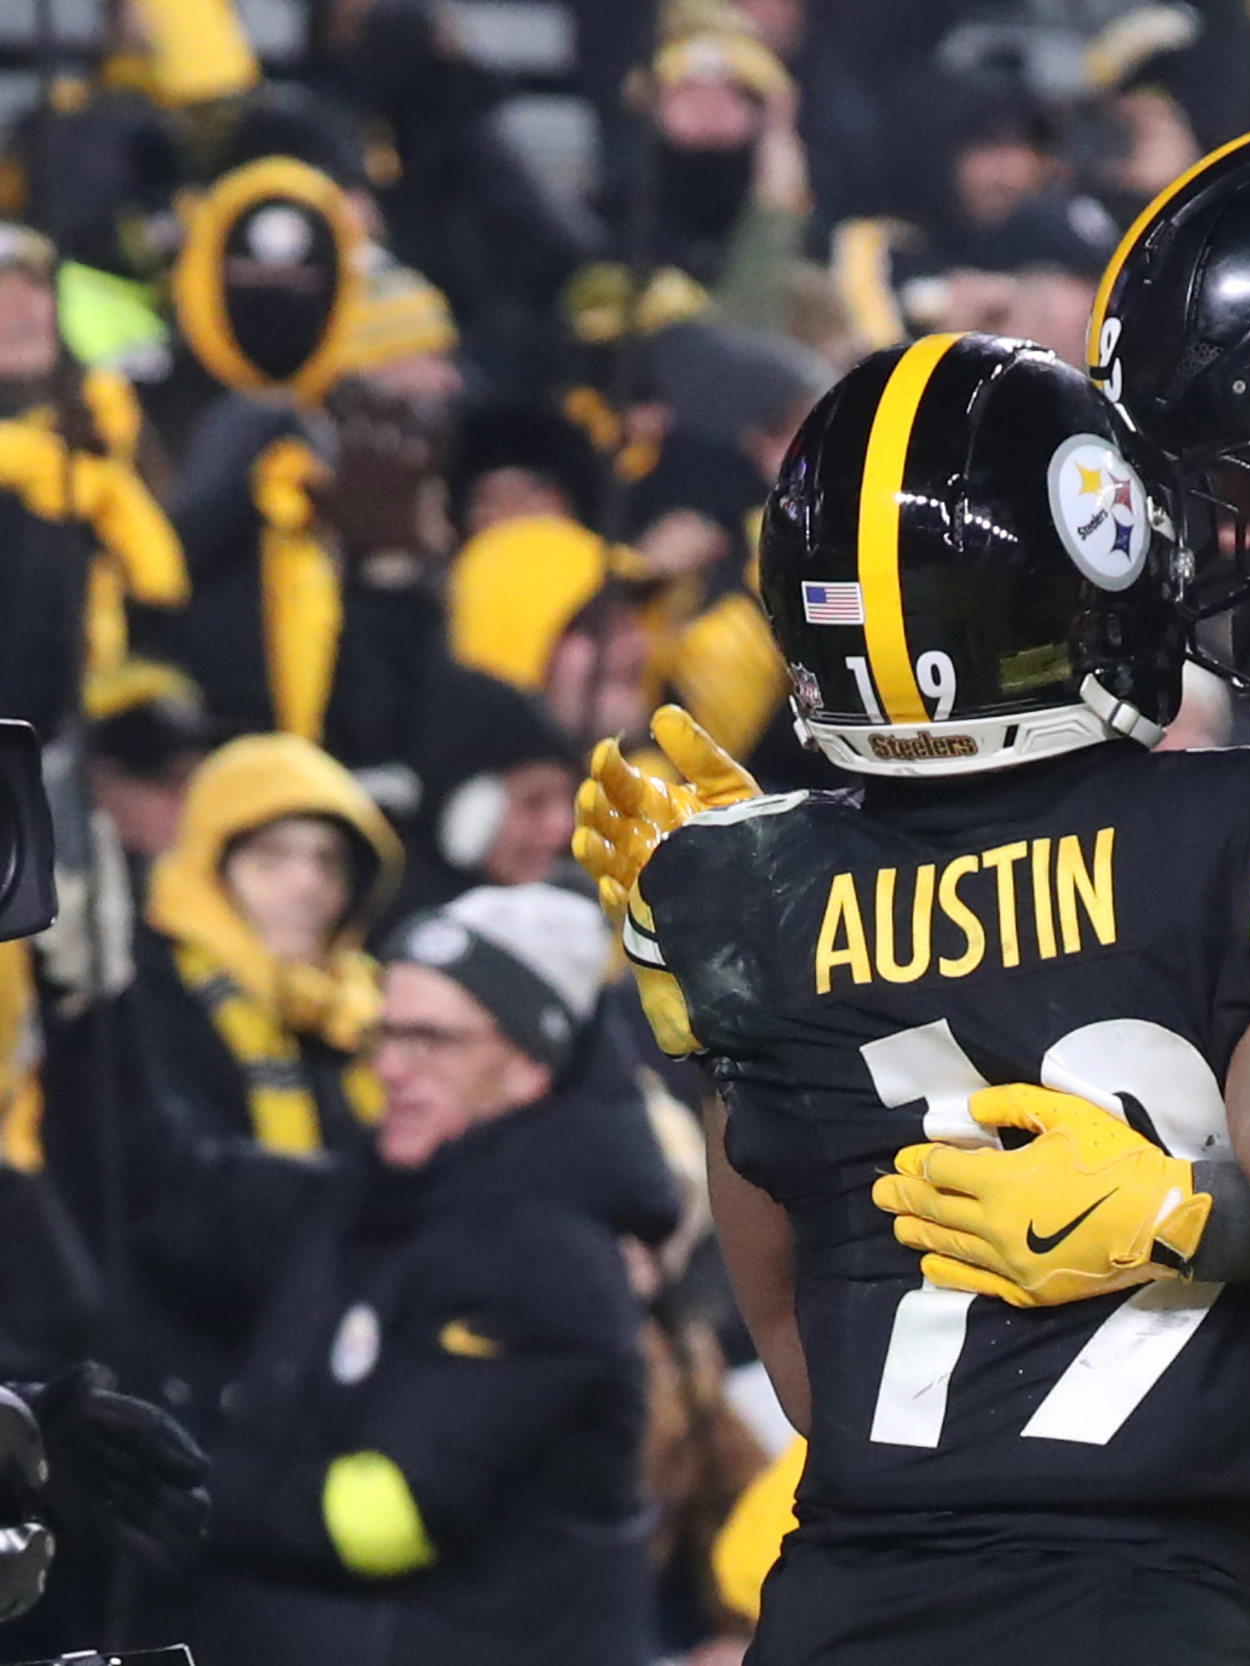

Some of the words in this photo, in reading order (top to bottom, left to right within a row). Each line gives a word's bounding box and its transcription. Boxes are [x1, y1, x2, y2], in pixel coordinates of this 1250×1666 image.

[845, 650, 957, 724] 19
[868, 730, 978, 760] Steelers
[815, 827, 1116, 994] AUSTIN
